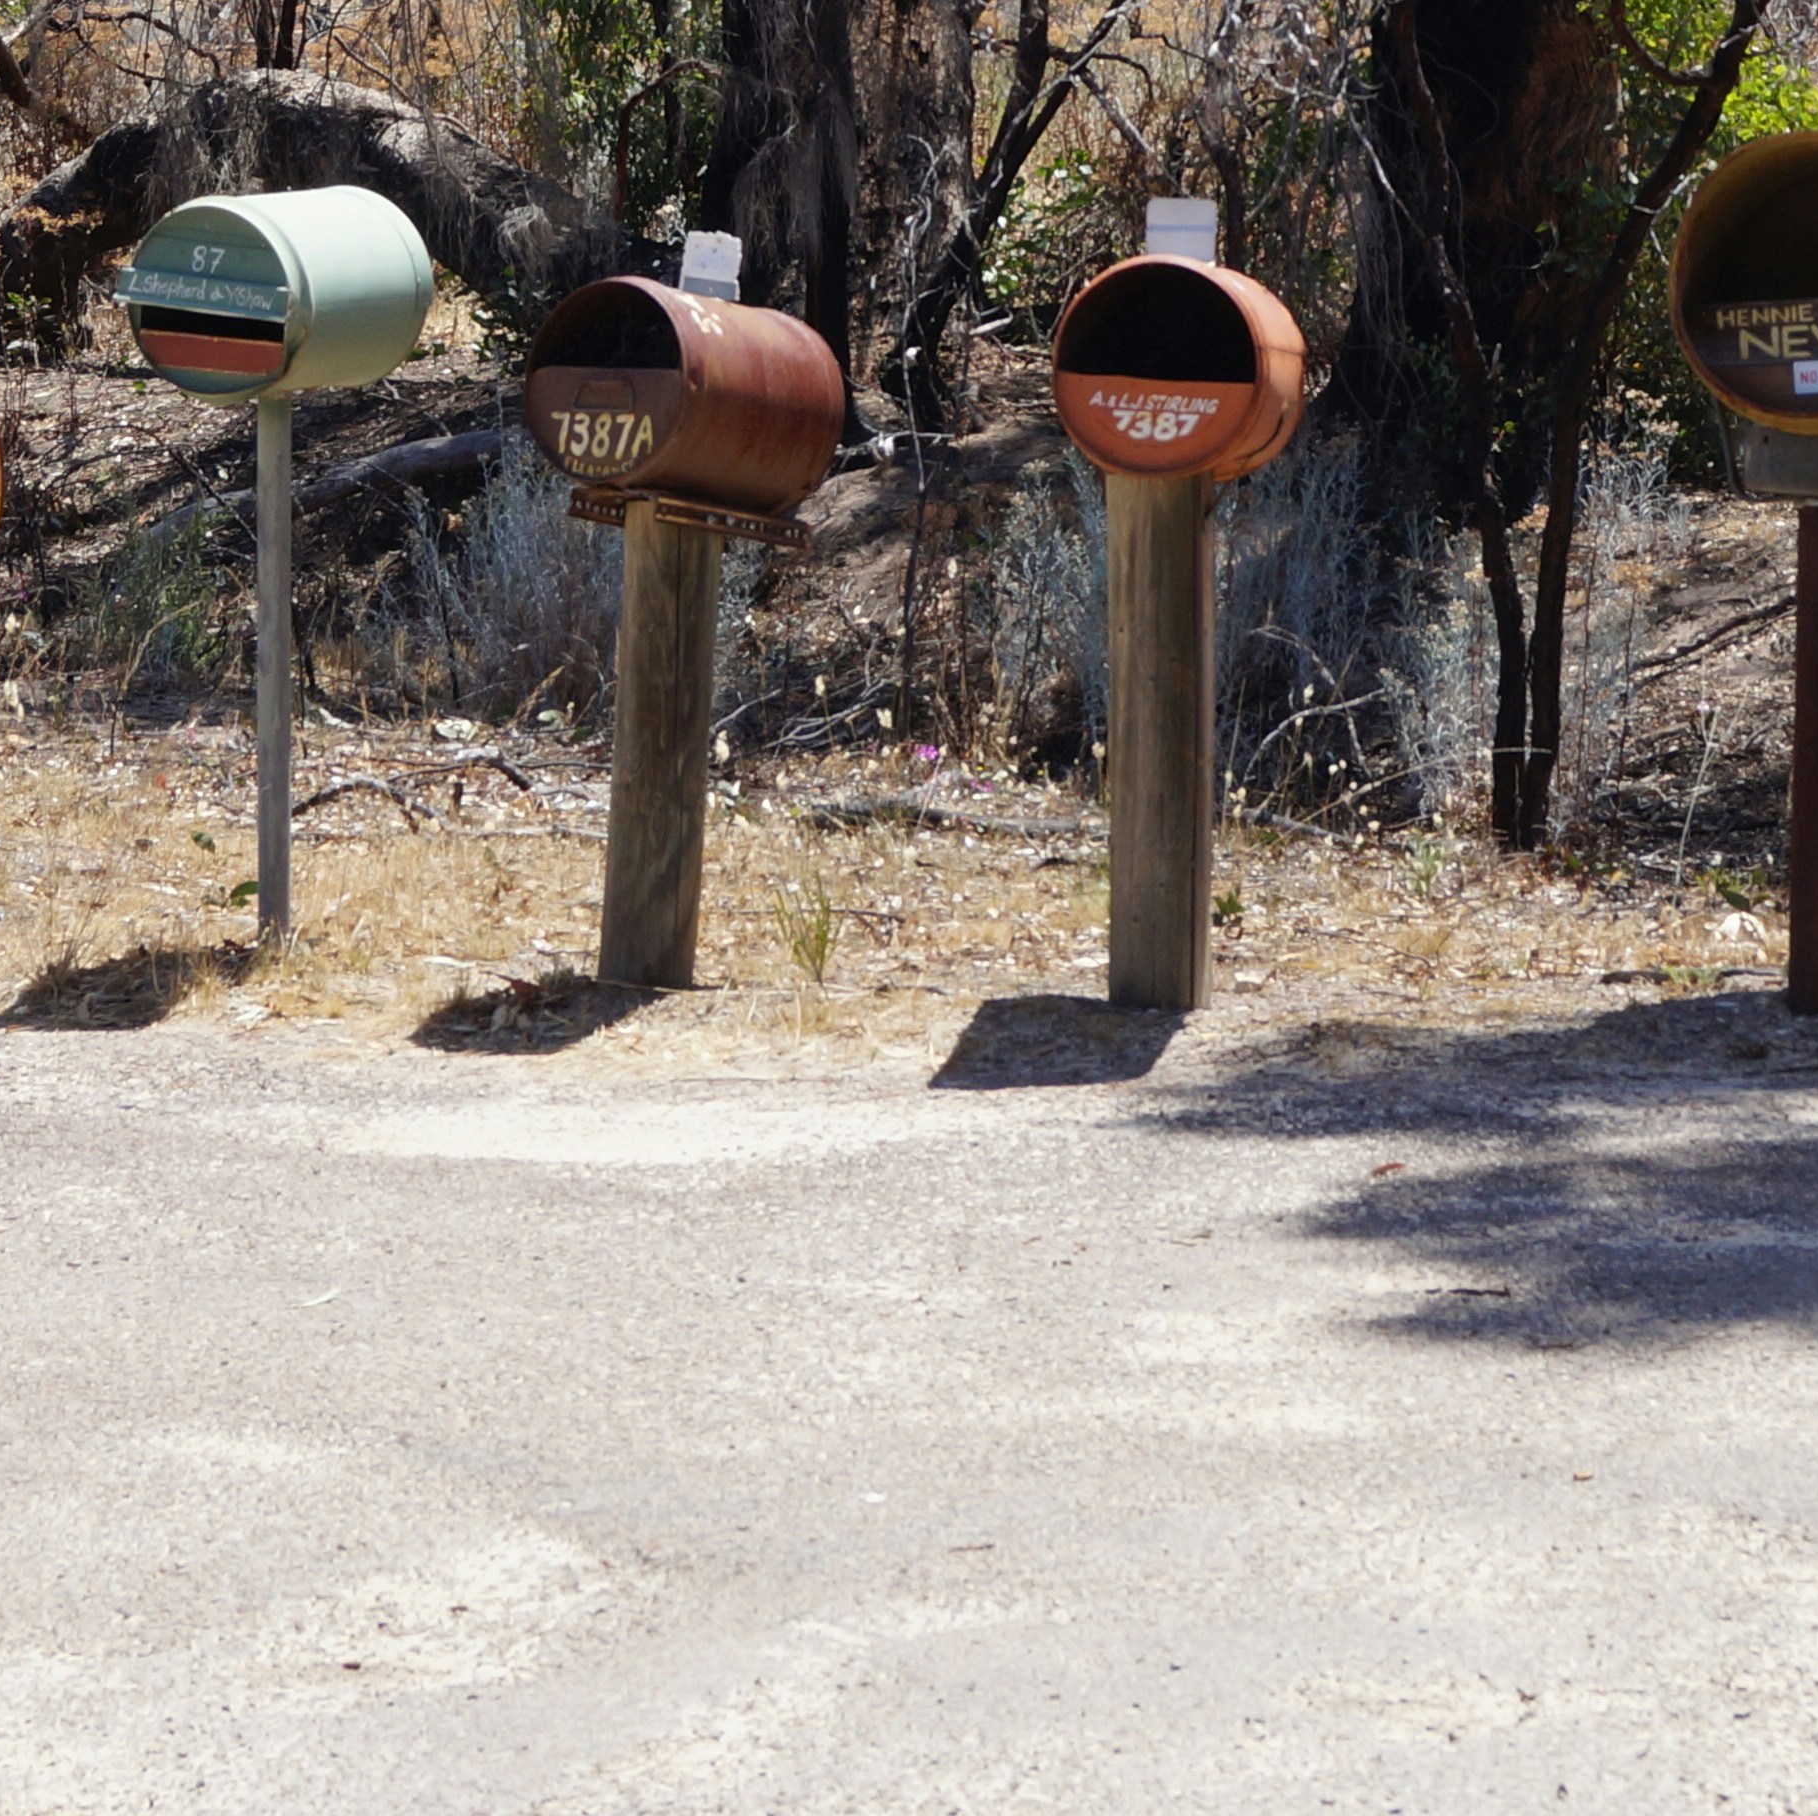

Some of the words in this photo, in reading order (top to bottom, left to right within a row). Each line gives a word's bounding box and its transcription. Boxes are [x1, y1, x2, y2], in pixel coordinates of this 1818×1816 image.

[191, 244, 226, 275] 87
[1716, 303, 1815, 330] HENNIE
[550, 410, 654, 461] 7387A
[1112, 409, 1200, 441] 7387
